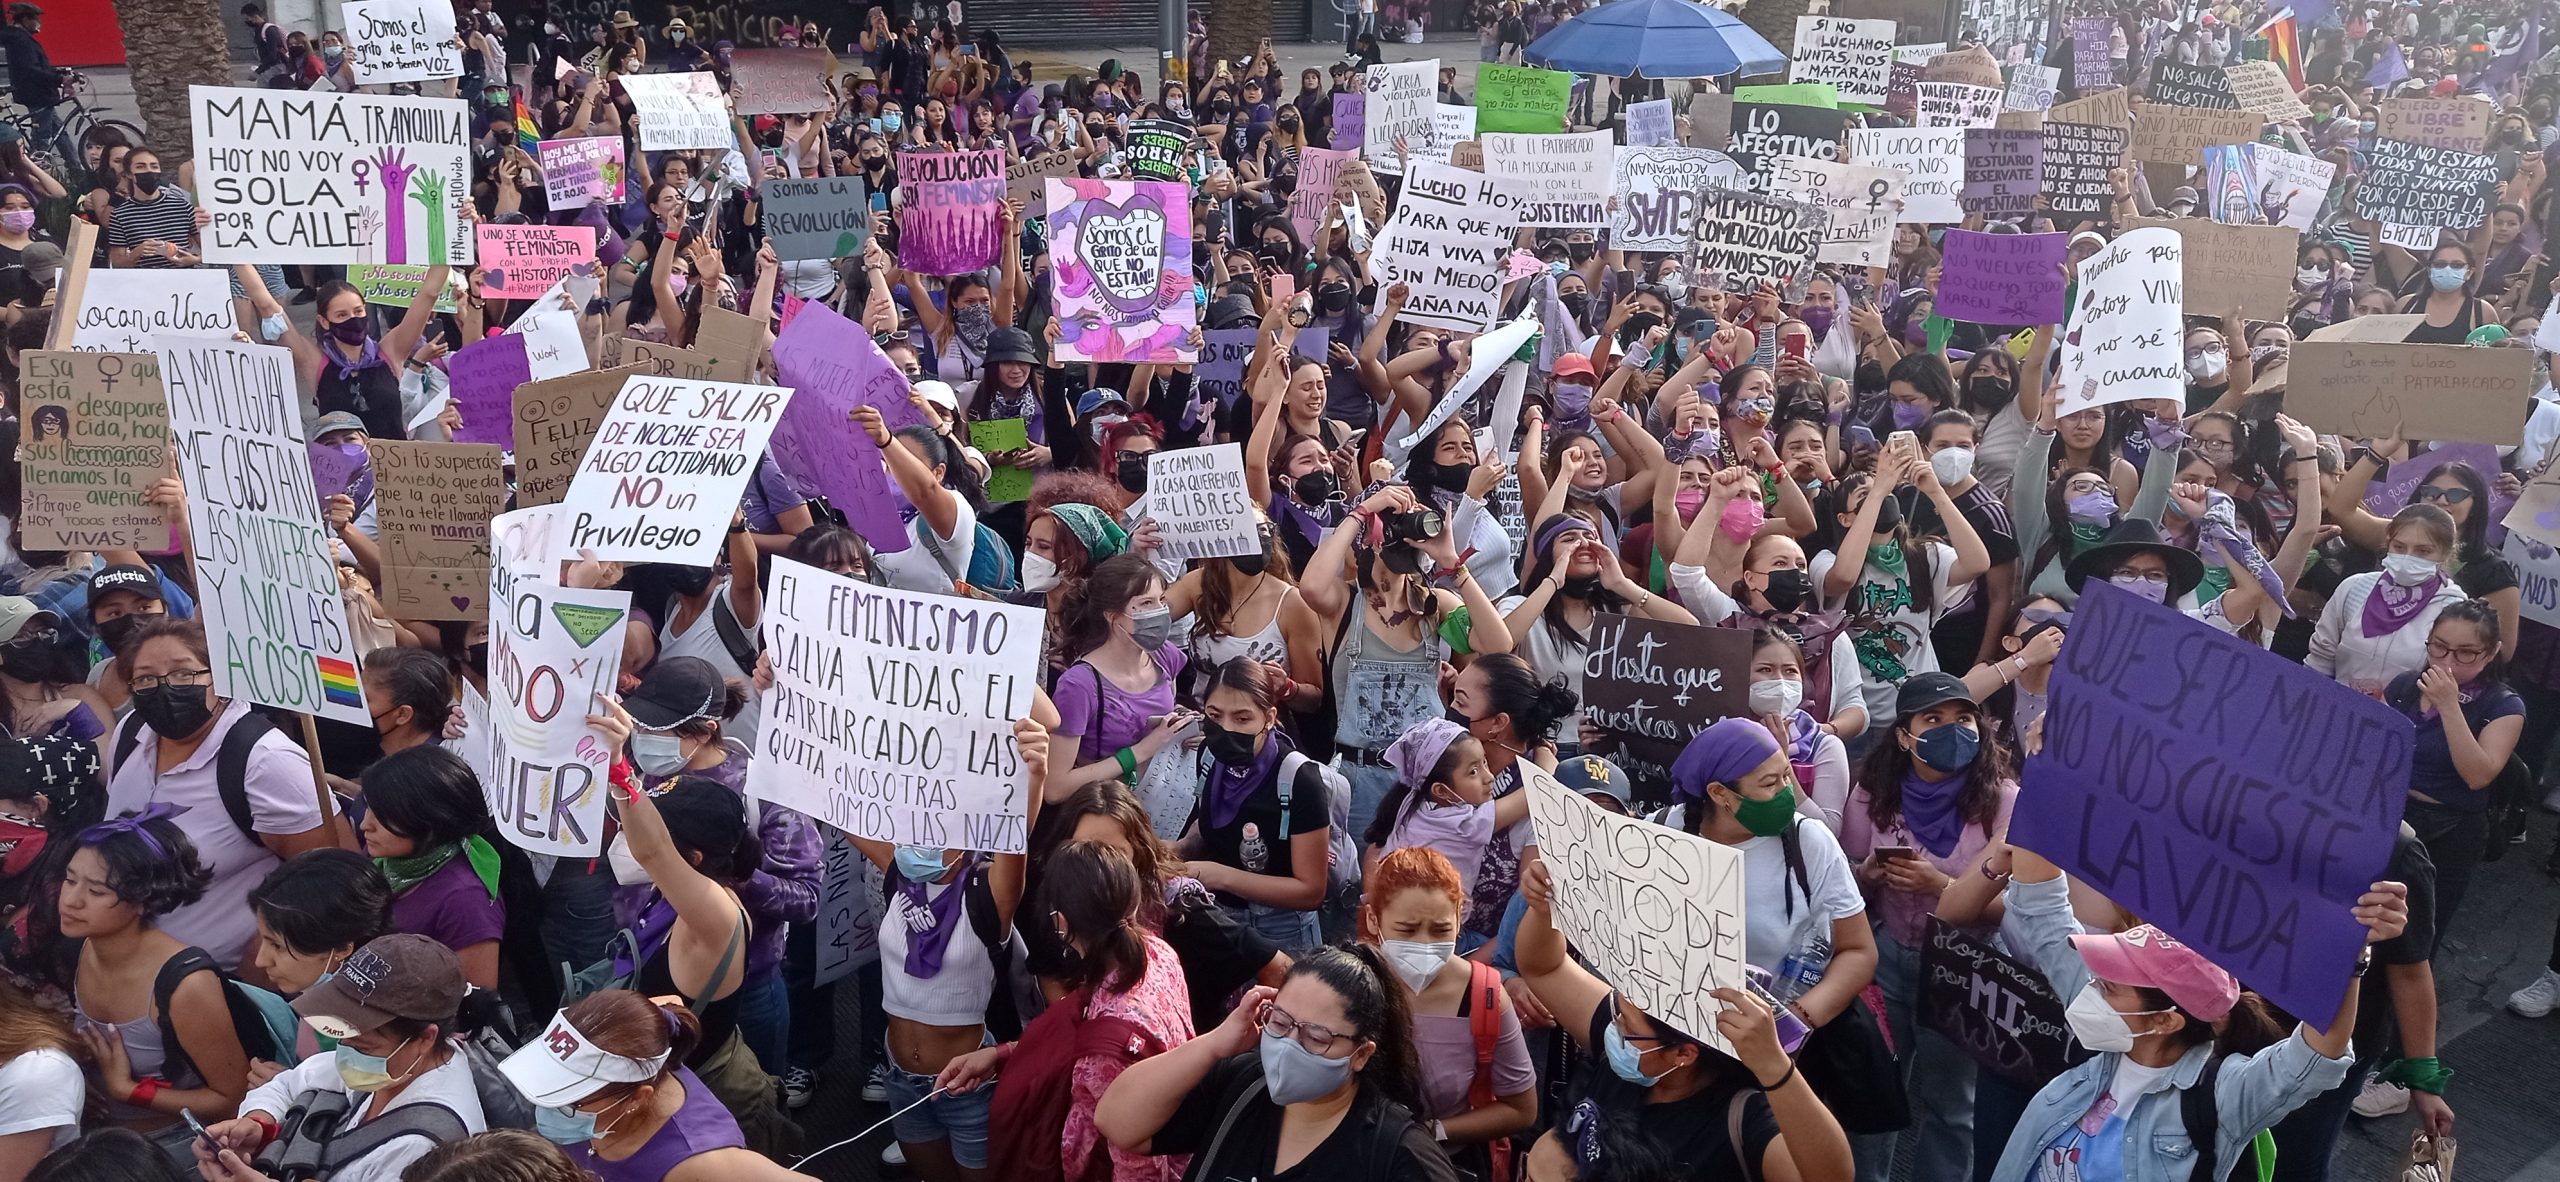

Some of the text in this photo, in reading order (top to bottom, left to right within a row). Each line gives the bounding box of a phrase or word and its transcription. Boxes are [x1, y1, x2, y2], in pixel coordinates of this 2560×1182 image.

[358, 7, 427, 40] Somos el
[1812, 19, 1856, 33] SI NO
[357, 38, 454, 64] grito de las que
[1821, 35, 1893, 51] LUCHAMOS
[362, 57, 451, 76] ya no tienen VOZ
[1919, 84, 1969, 100] VALIENTE
[206, 95, 468, 148] MAMÁ, TRANQUILA,
[1385, 100, 1417, 122] A LA
[1748, 108, 1780, 135] LO
[2406, 113, 2465, 127] LIBRE
[2422, 127, 2445, 135] NO
[1492, 135, 1594, 154] QUE EL PATRIARCADO
[1731, 129, 1838, 160] AFECTIVO
[2043, 137, 2120, 154] NO PUDO DECIR
[209, 147, 343, 173] HOY NO VOY
[1919, 157, 1949, 174] NOS
[1967, 155, 2034, 168] VESTUARIO
[2042, 151, 2119, 167] NADA PERO MI
[2371, 153, 2499, 183] TODAS NUESTRAS
[549, 178, 567, 191] QUE
[1778, 158, 1828, 187] ESTO
[1966, 169, 2034, 182] RESERVATE
[2367, 169, 2479, 196] VOCES JUNTAS
[214, 177, 345, 207] SOLA
[923, 178, 1005, 209] FEMINISTA
[1993, 184, 2010, 195] EL
[2052, 197, 2100, 211] CALLADA
[483, 229, 558, 241] UNO SE VUELVE
[767, 208, 866, 236] REVOLUCIÓN
[1398, 204, 1516, 240] PARA QUE MI
[2382, 223, 2433, 247] GRITAR
[504, 240, 581, 257] FEMINISTA
[1391, 236, 1485, 265] HIJA VIVA
[500, 257, 570, 267] CON SU PROPIA
[1093, 258, 1144, 272] QUE NO
[1949, 254, 2050, 276] NO VUELVES
[1387, 265, 1498, 292] SIN MIEDO
[2085, 295, 2131, 323] estoy
[24, 379, 72, 400] está
[2320, 371, 2516, 391] aplasto al PATRIARCADO
[76, 393, 166, 421] desapare
[623, 383, 781, 423] QUE SALIR
[531, 418, 598, 446] FELIZ
[601, 421, 746, 451] DE NOCHE SEA
[24, 465, 132, 487] llenamos la
[173, 428, 225, 506] ME
[221, 434, 318, 523] GUSTAN
[585, 450, 746, 476] ALGO COTIDIANO
[610, 476, 697, 511] NO un
[1153, 470, 1240, 496] A CASA QUEREMOS
[35, 493, 82, 513] Porque
[375, 487, 499, 509] que la que salga
[1153, 491, 1245, 517] SER LIBRES
[28, 514, 162, 527] HOY TODAS estamos
[382, 519, 487, 539] sea mi mamá
[569, 512, 701, 551] Privilegio
[56, 530, 126, 546] VIVAS
[189, 504, 336, 597] LAS MUJERES
[198, 564, 342, 654] Y NO LAS
[780, 575, 1009, 656] EL FEMINISMO
[227, 630, 323, 712] ACOSO
[1585, 617, 1723, 708] Hasta que
[2066, 592, 2400, 833] QUE SER MUJER
[772, 681, 1018, 778] PATRIARCADO LAS
[2044, 684, 2363, 906] NO NOS CUESTE
[823, 787, 1026, 853] SOMOS LAS NAZIS
[1533, 774, 1690, 886] SOMOS
[1534, 816, 1738, 962] EL GRITO DE
[2077, 792, 2299, 995] LA VIDA
[343, 966, 367, 987] FRANCE
[1969, 971, 2026, 1022] MI
